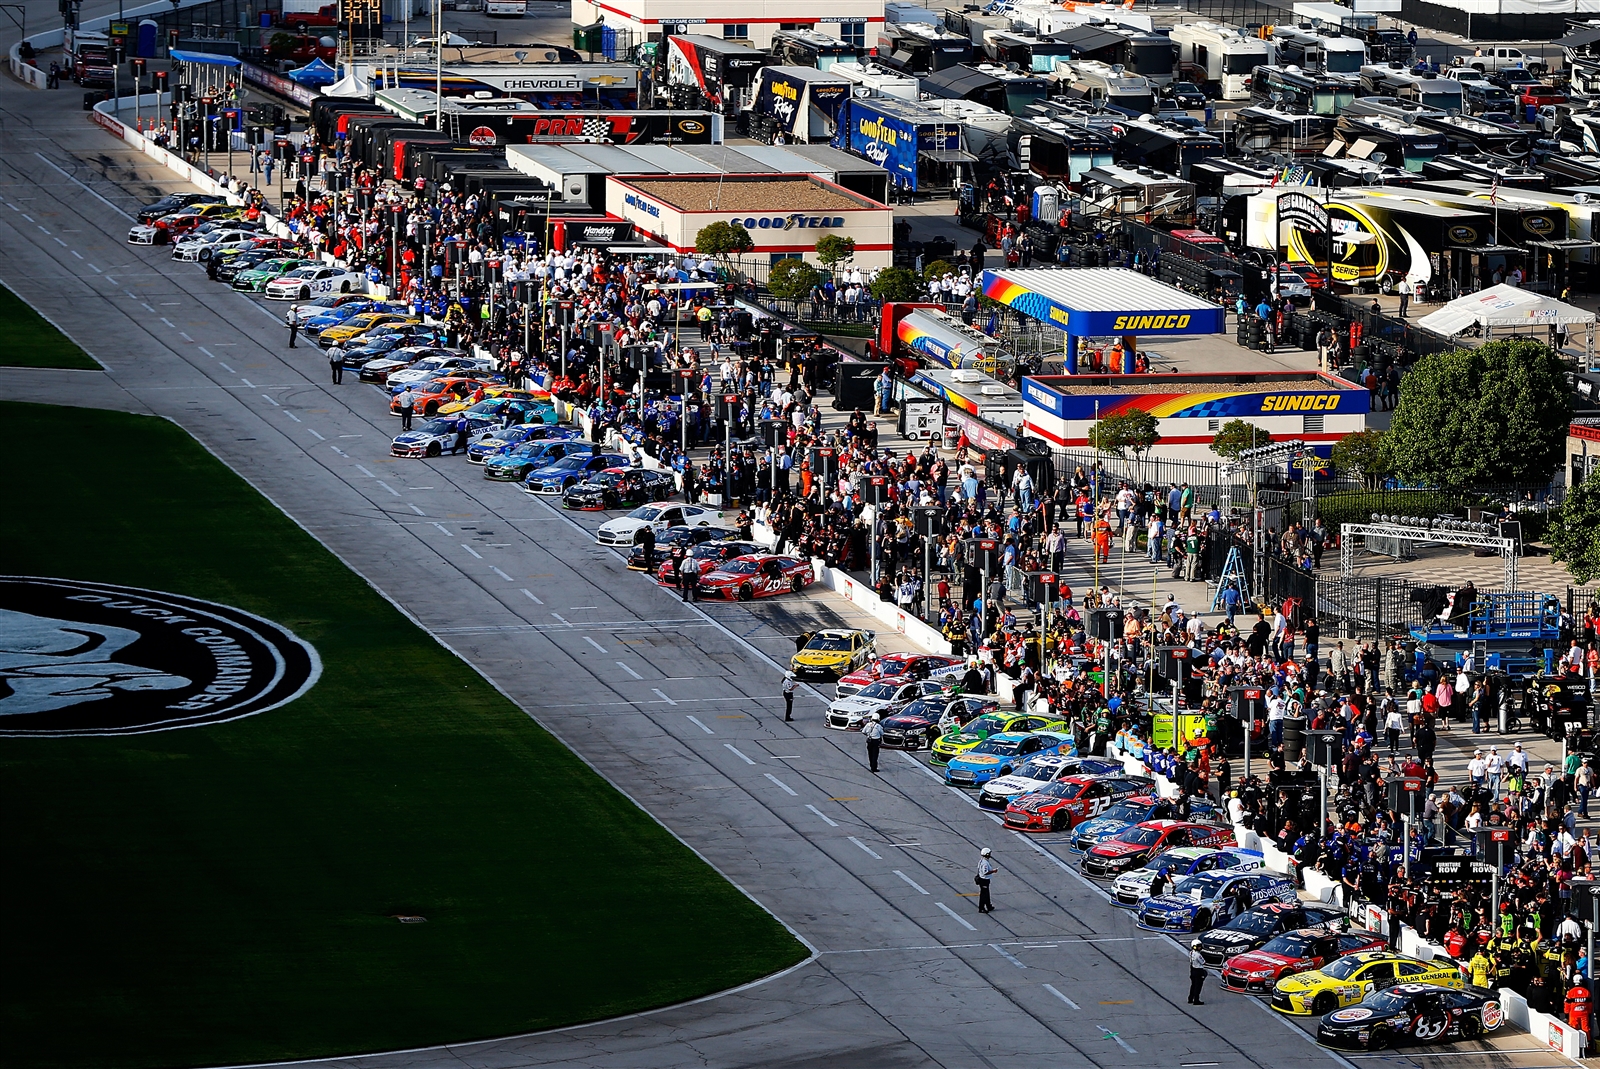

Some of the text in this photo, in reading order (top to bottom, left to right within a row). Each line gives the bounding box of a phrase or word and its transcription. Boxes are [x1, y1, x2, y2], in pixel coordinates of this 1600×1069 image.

[504, 80, 582, 88] CHEVROLET
[772, 81, 797, 101] GOODYEAR
[534, 118, 584, 135] PRN
[860, 117, 897, 147] GOODYEAR
[866, 142, 889, 168] Racing
[647, 204, 660, 218] EAGLE
[731, 214, 845, 230] GOODYEAR
[584, 226, 615, 235] Hendrick
[1335, 266, 1359, 276] SERIES
[320, 280, 333, 292] 35
[1050, 306, 1069, 325] SUNOCO
[1113, 315, 1190, 330] SUNOCO
[929, 405, 941, 413] 14
[1261, 395, 1341, 411] SUNOCO
[526, 408, 548, 418] Zest
[472, 426, 498, 436] ADVOCARE
[66, 595, 198, 624] DUCK
[165, 627, 252, 710] COMMANDER
[1086, 796, 1110, 818] 32
[1251, 883, 1290, 899] ProServices
[1422, 972, 1450, 980] GENERAL
[1484, 1010, 1500, 1023] KING
[1415, 1017, 1442, 1038] 83
